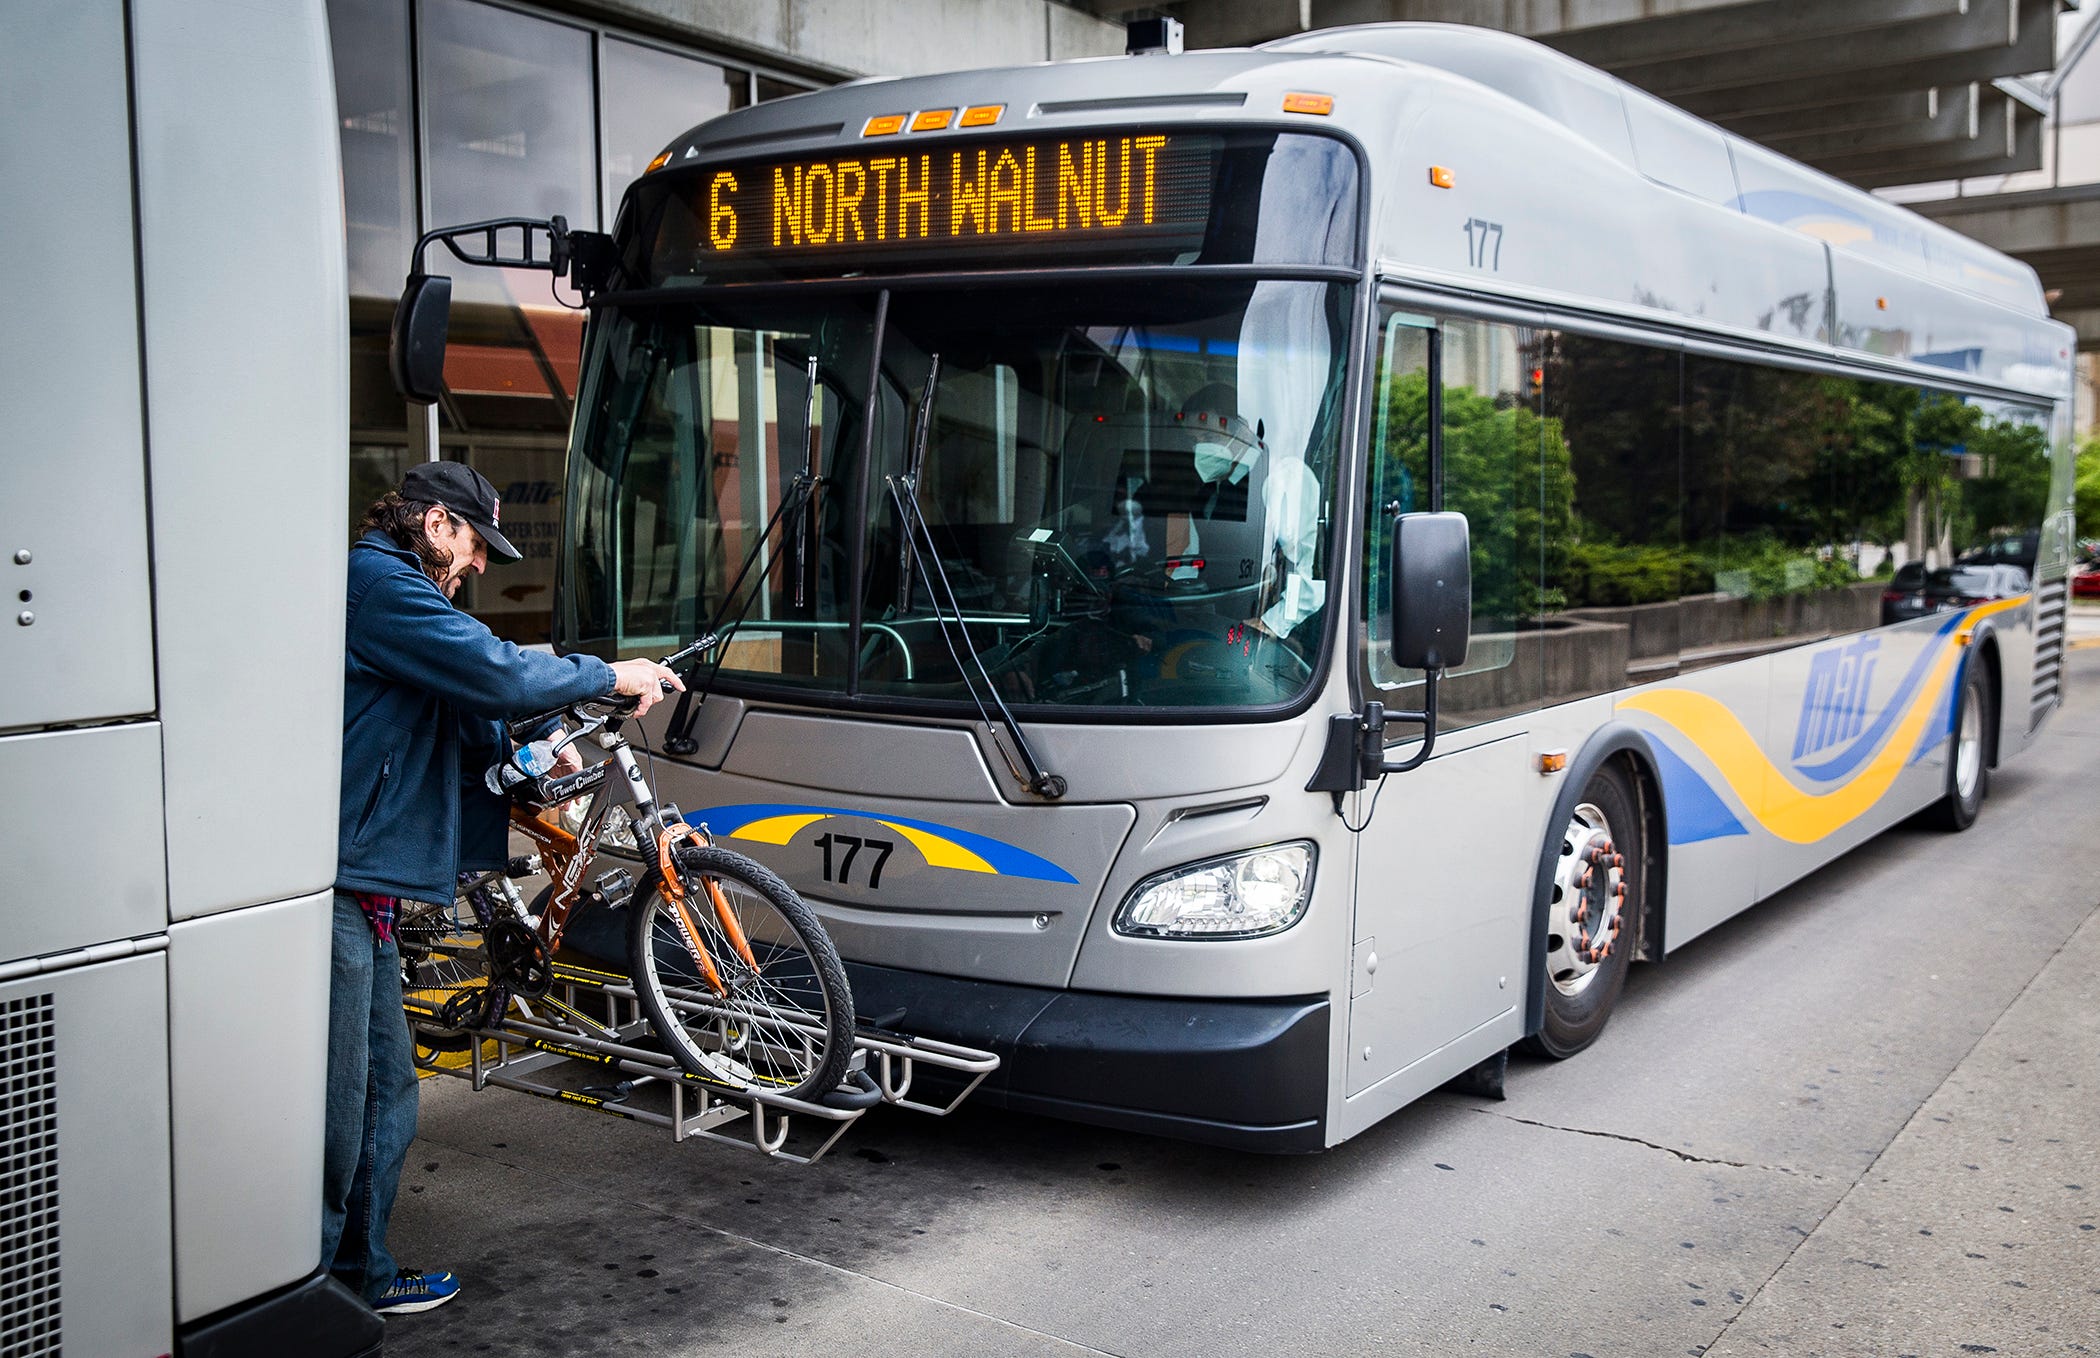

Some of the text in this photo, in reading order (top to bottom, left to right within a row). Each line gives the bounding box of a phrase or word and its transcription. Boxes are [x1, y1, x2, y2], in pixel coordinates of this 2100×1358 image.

[710, 134, 1167, 249] 6 NORTH WALNUT
[1463, 217, 1503, 272] 177
[814, 832, 894, 889] 177
